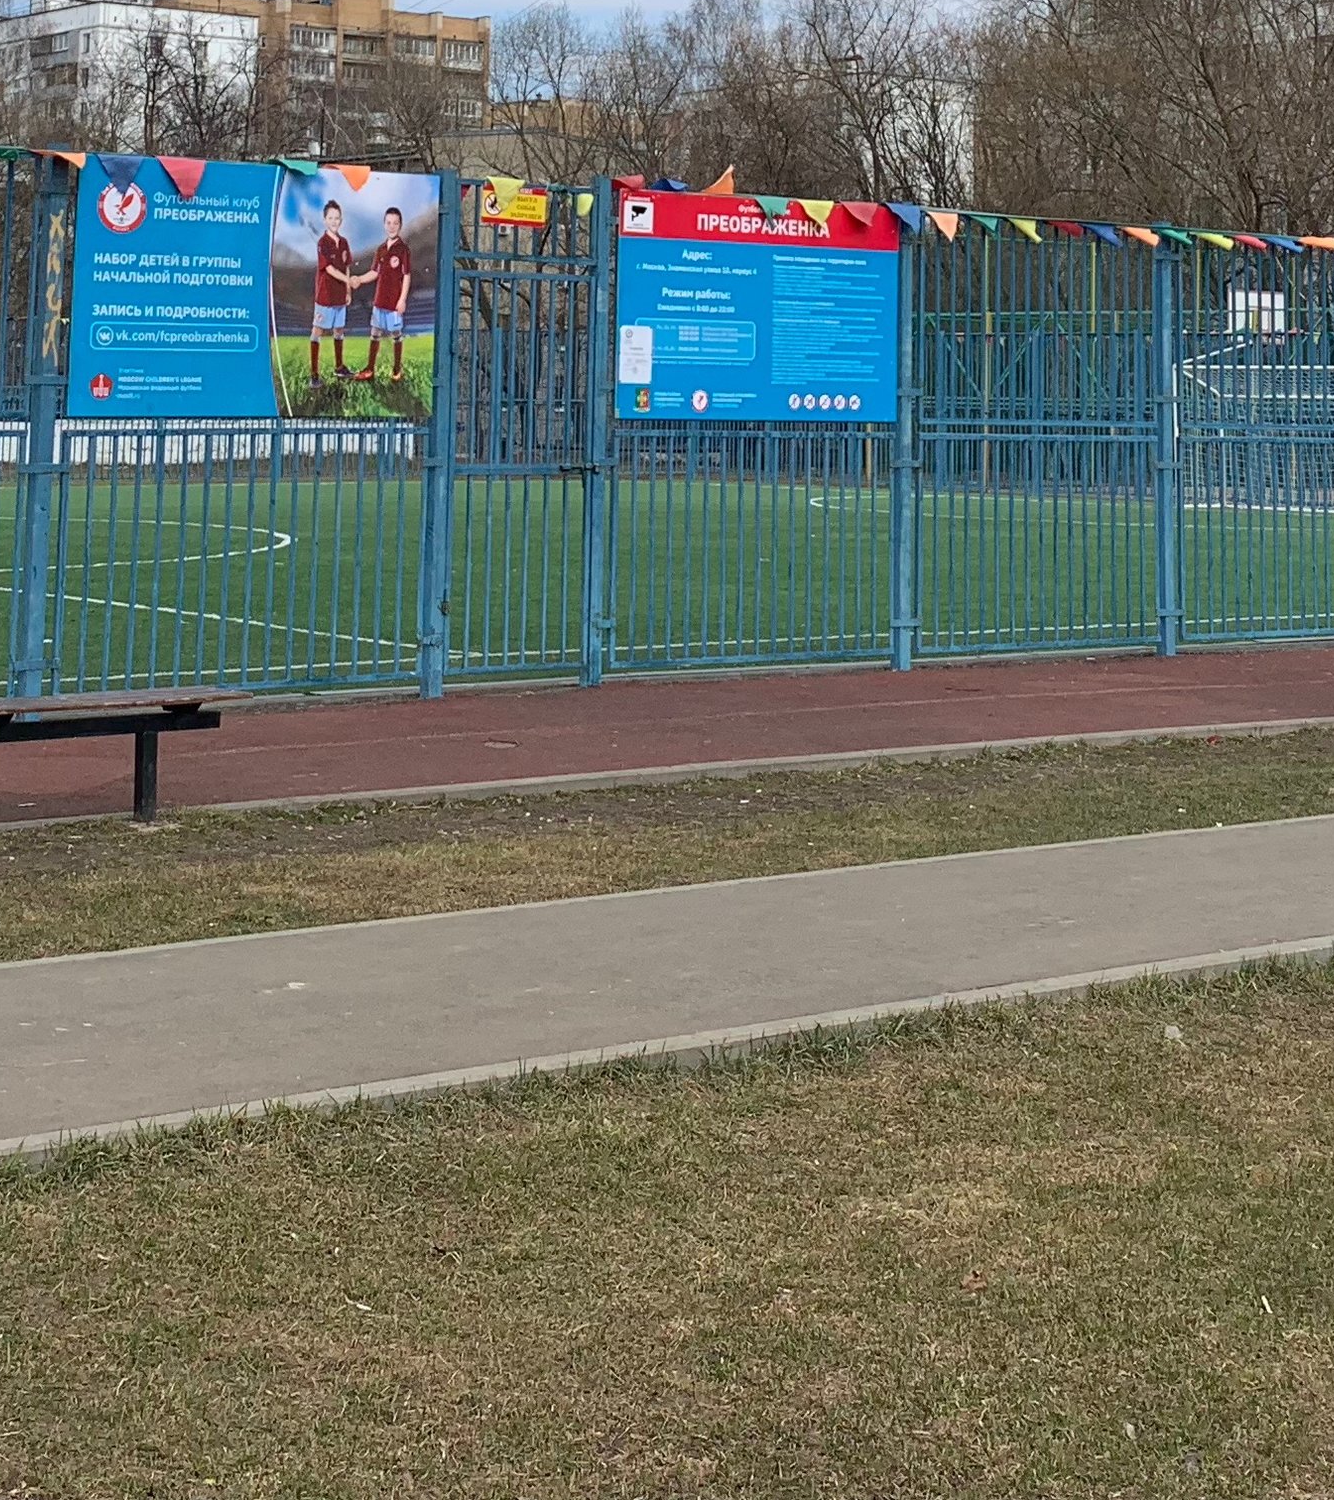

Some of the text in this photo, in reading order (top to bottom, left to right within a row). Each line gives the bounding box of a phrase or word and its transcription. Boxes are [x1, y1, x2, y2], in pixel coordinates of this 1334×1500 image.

[232, 195, 260, 211] клуб
[153, 207, 260, 224] ПРЕОБРАЖЕНКА
[696, 213, 831, 238] ПРЕОБРАЖЕНКА
[94, 252, 242, 269] НАБОР ДЕТЕЙ В ГРУППЫ
[682, 248, 713, 261] Адрес:
[93, 269, 254, 287] НАЧАЛЬНОЙ ПОДГОТОВКИ
[662, 287, 731, 300] Режим работы:
[92, 304, 250, 319] ЗАПИСЬ И ПОДРОБНОСТИ:
[115, 329, 250, 344] vk.com/fcpreobrazhenka
